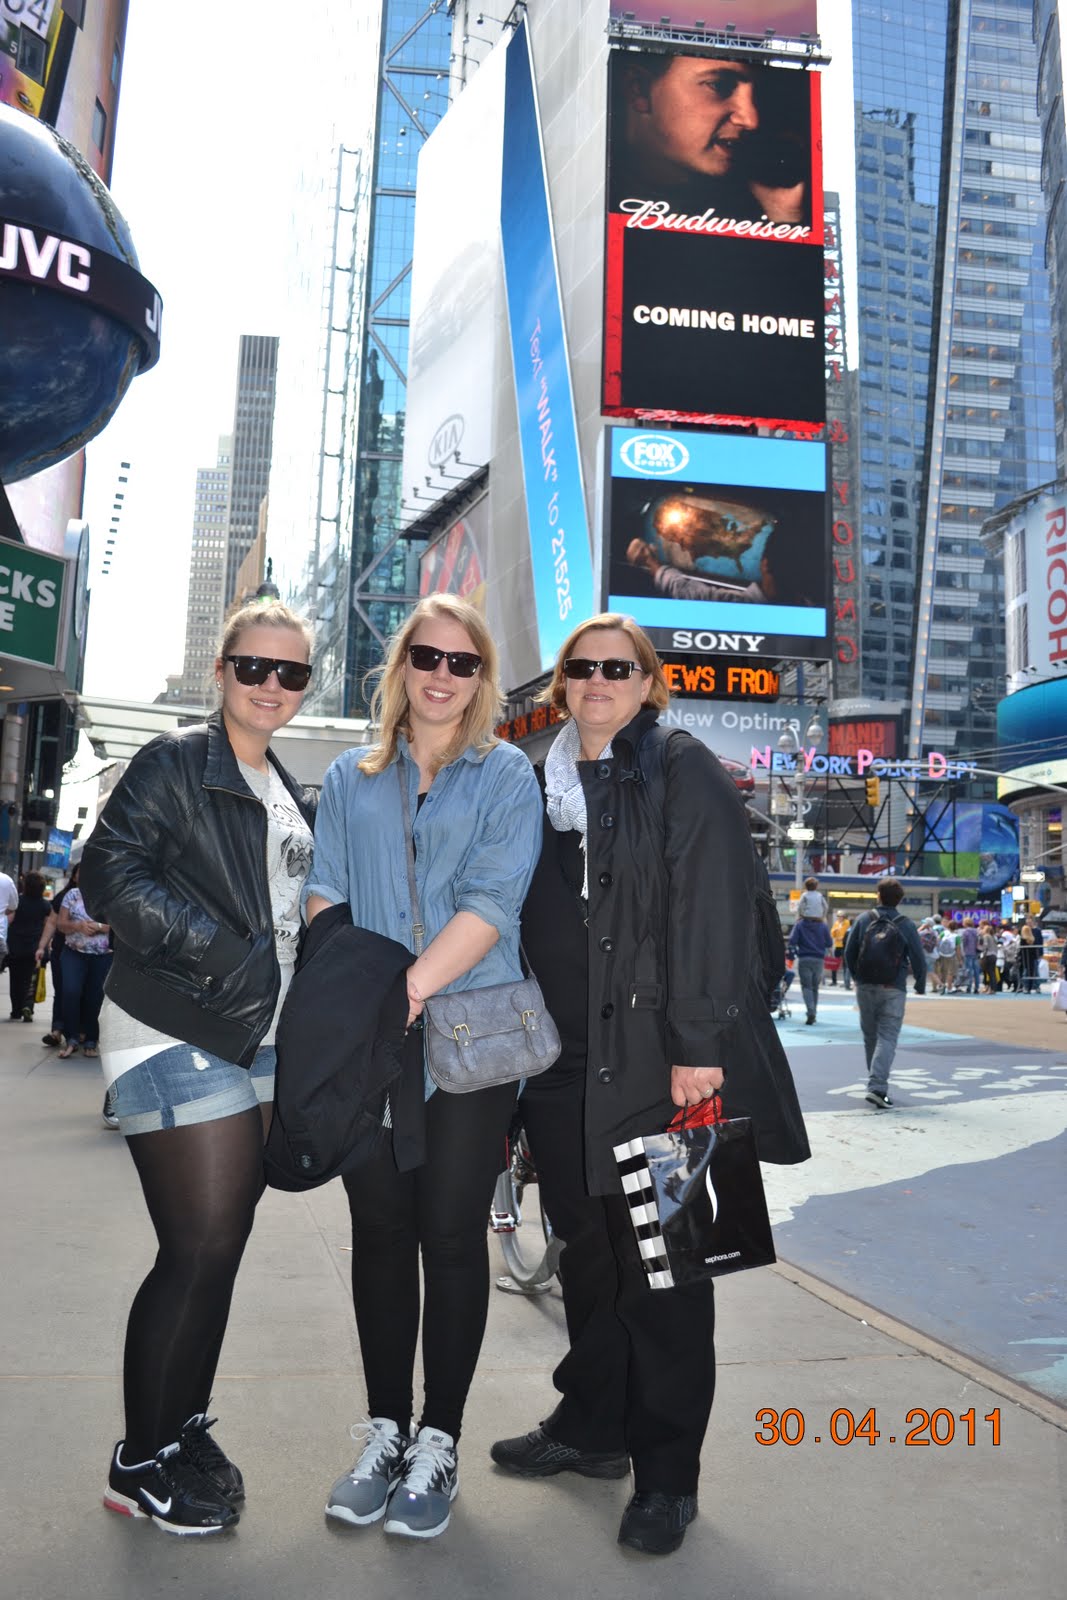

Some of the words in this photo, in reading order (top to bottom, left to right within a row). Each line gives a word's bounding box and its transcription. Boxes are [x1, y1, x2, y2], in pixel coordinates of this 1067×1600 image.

[619, 198, 811, 240] Budweiser
[0, 223, 91, 292] JVC
[633, 305, 735, 331] COMING
[742, 314, 815, 338] HOME
[434, 424, 458, 462] KIA
[634, 441, 676, 466] FOX
[551, 528, 573, 621] 21525
[1046, 507, 1067, 662] RICOH
[673, 631, 765, 652] SONY
[721, 711, 800, 733] Optima
[751, 745, 797, 772] NEW
[799, 746, 852, 774] YORK
[857, 749, 922, 778] POLICE
[705, 1251, 740, 1264] sephora.com
